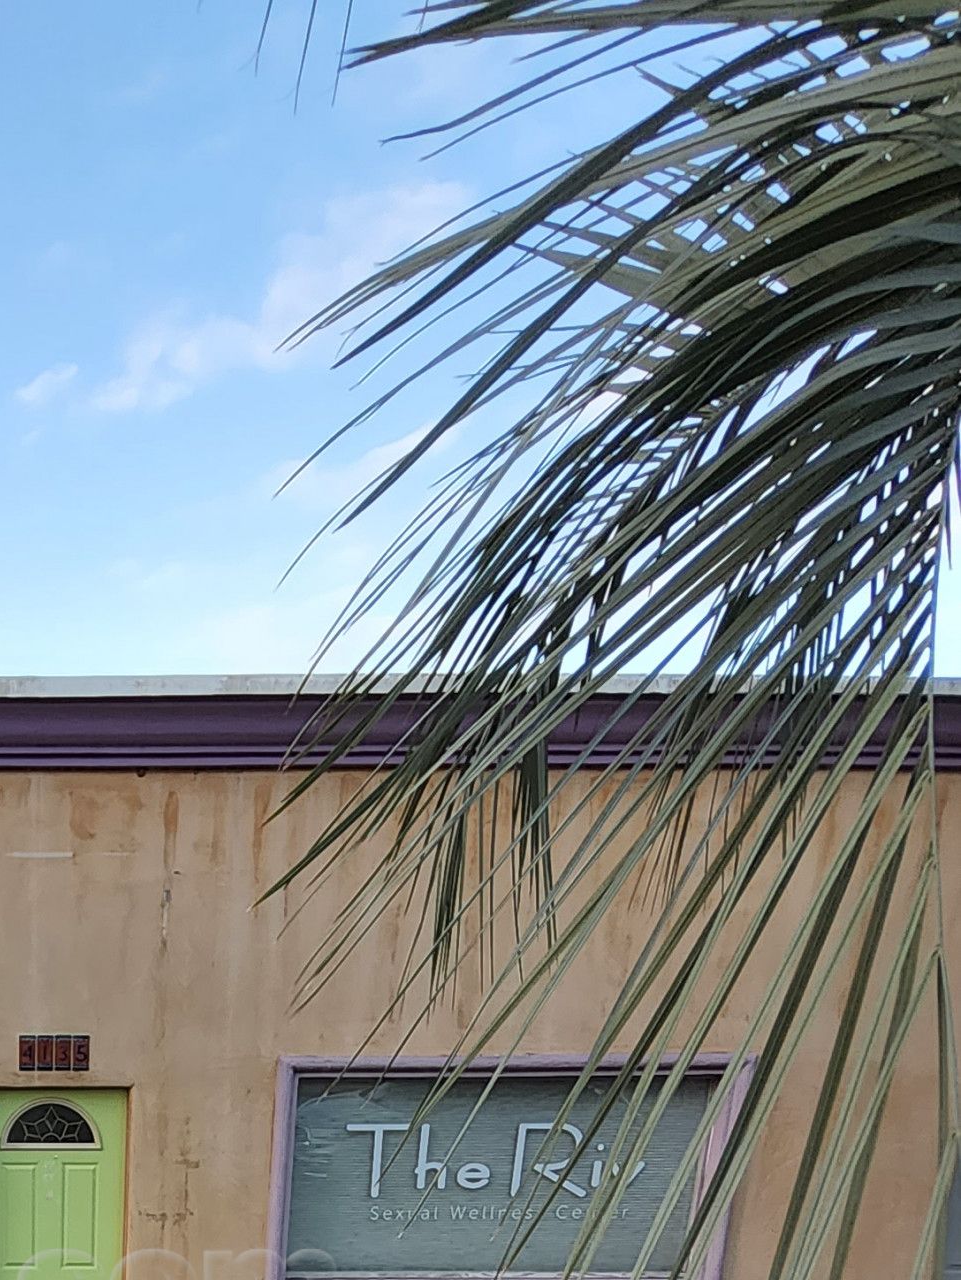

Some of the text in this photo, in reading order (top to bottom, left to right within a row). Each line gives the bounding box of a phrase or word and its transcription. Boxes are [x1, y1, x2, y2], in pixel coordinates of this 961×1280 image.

[21, 1042, 89, 1063] 4135
[345, 1122, 491, 1199] The
[369, 1203, 629, 1221] Sexual Wellnes Cer
